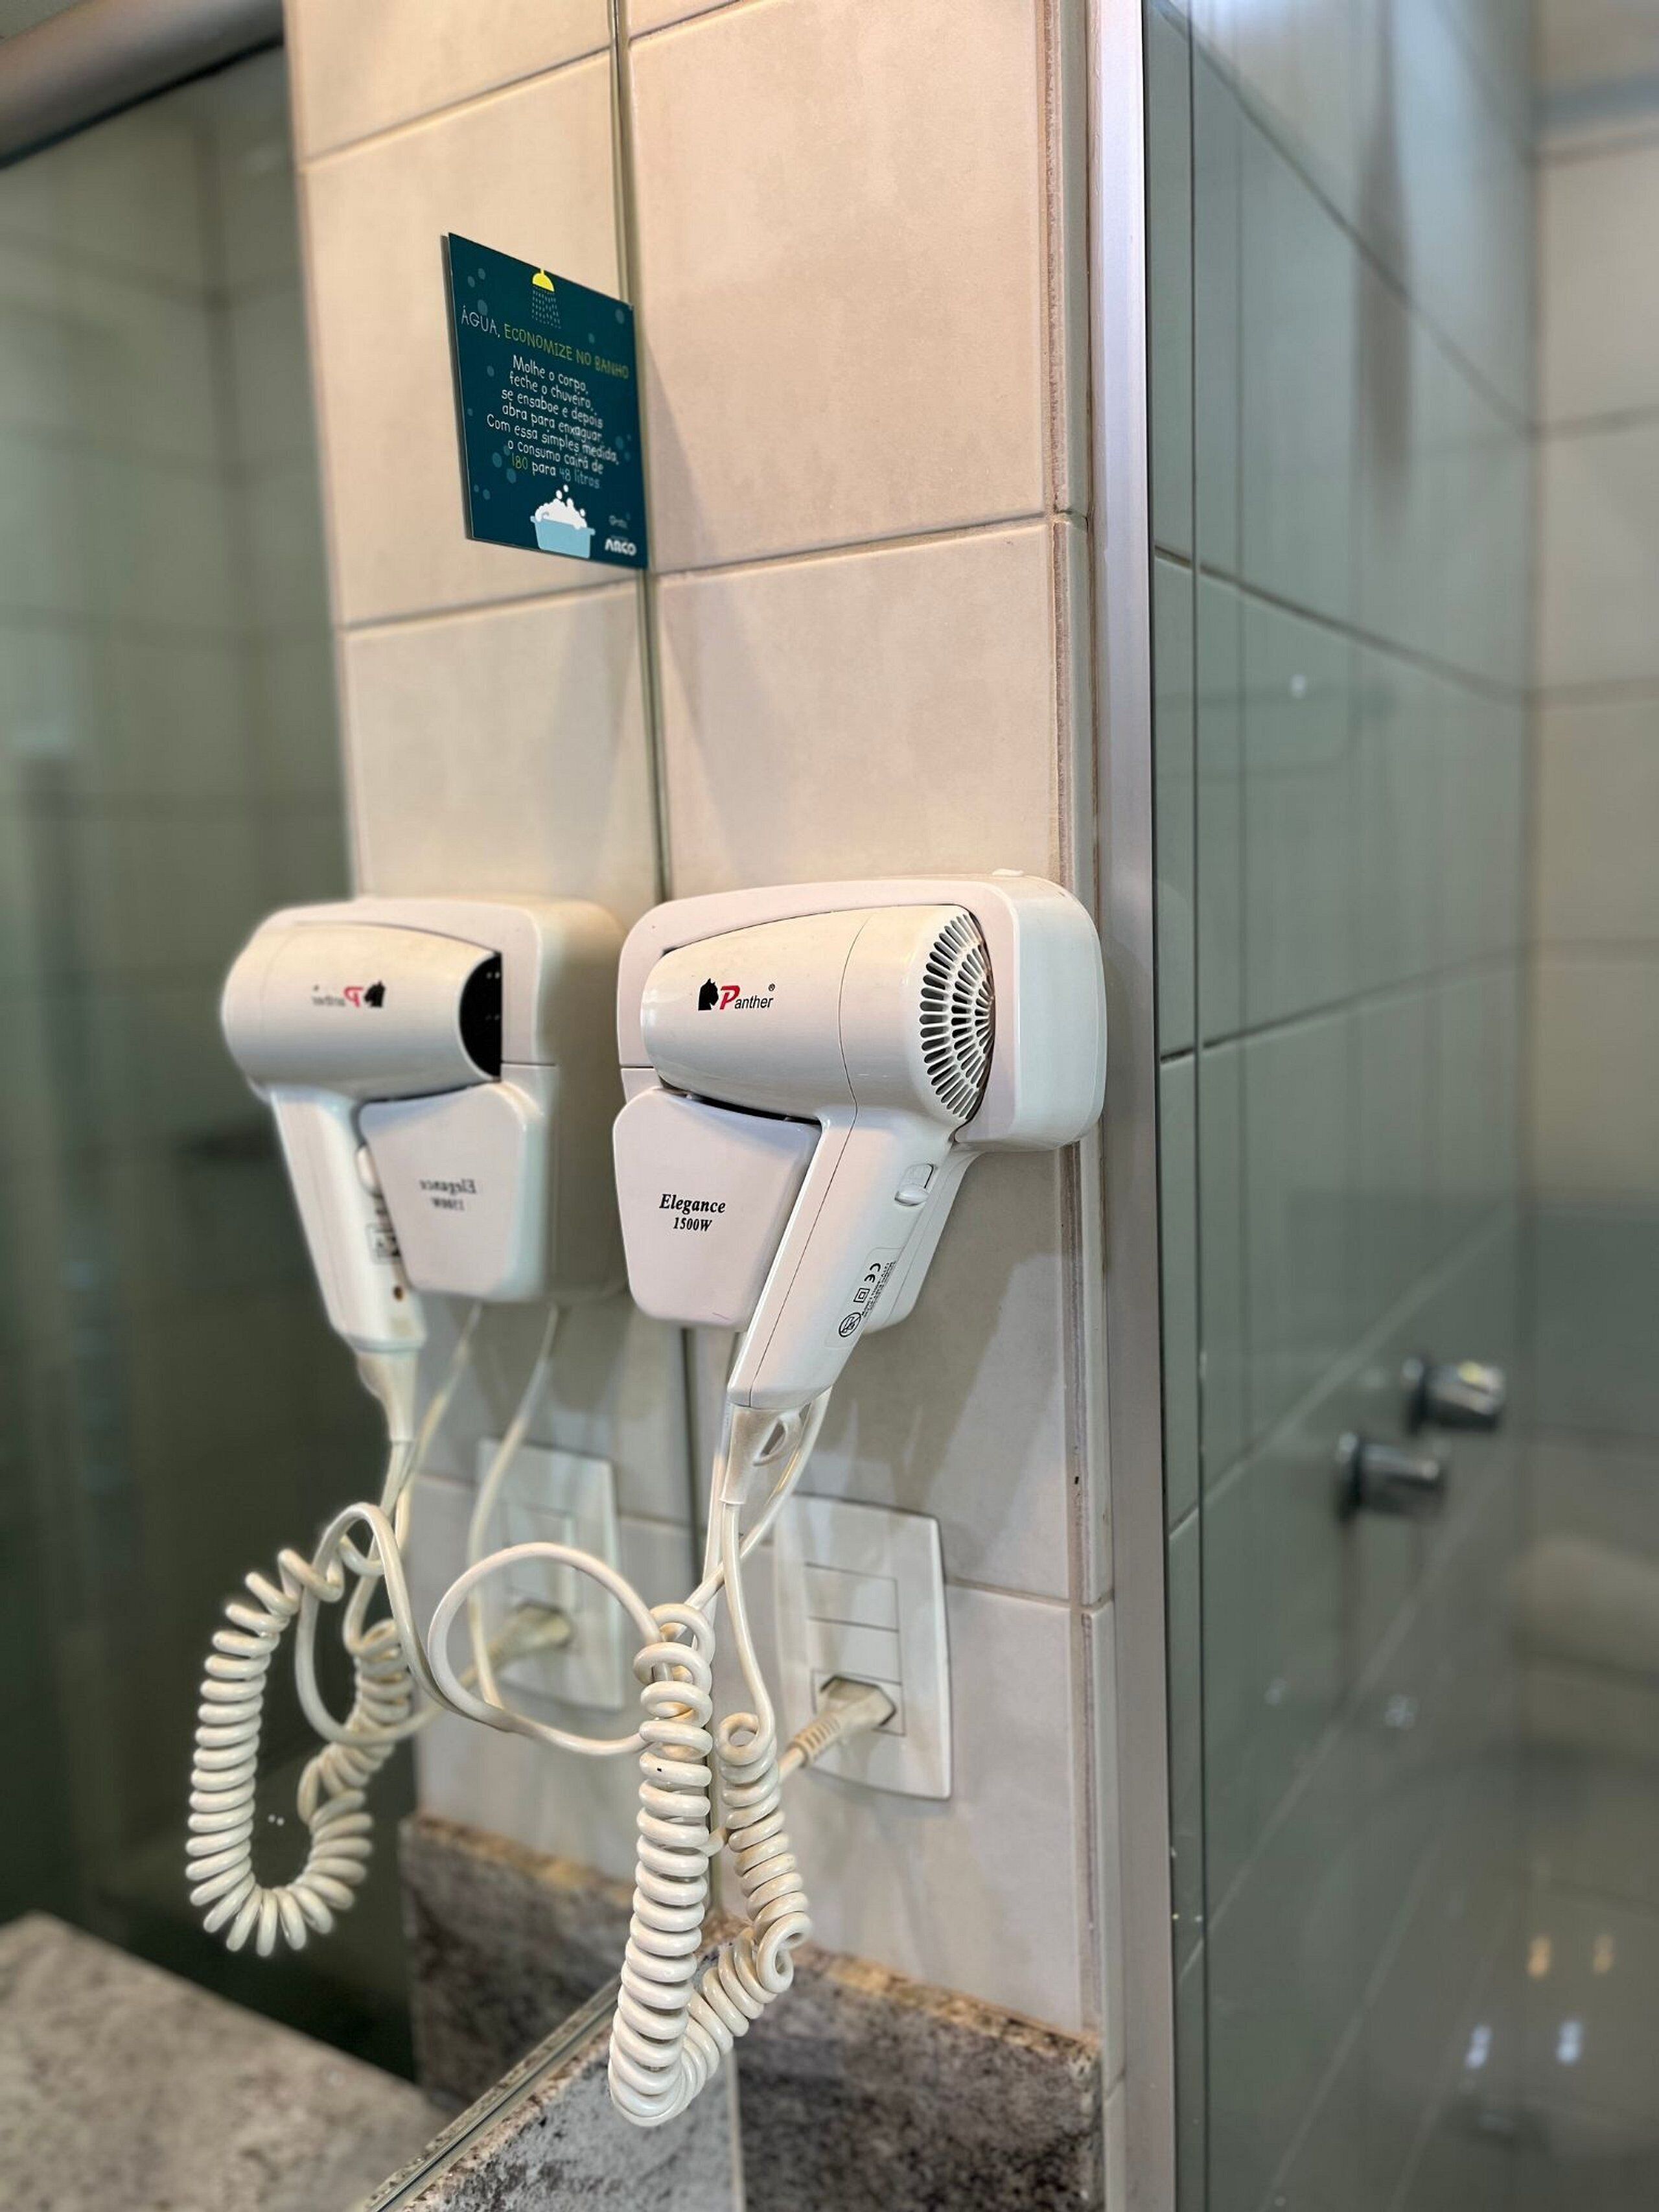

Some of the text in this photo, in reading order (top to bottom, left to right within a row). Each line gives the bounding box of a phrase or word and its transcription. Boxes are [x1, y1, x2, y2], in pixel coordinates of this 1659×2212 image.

[504, 324, 572, 360] ECONOMIZE
[575, 349, 592, 366] NO
[594, 356, 629, 379] BANHO
[509, 371, 538, 393] feche
[541, 385, 548, 395] o
[513, 355, 546, 379] Molhe
[549, 371, 555, 381] o
[501, 390, 603, 428] se ensaboe e depois
[502, 402, 528, 421] abra
[531, 413, 555, 429] para
[487, 413, 511, 433] Com
[515, 425, 538, 440] essa
[541, 429, 580, 452] simples
[507, 440, 604, 475] o consumo cairá de
[511, 452, 600, 489] 180 para 48 litros
[659, 1194, 726, 1215] Elegance
[673, 1217, 713, 1231] 1500W
